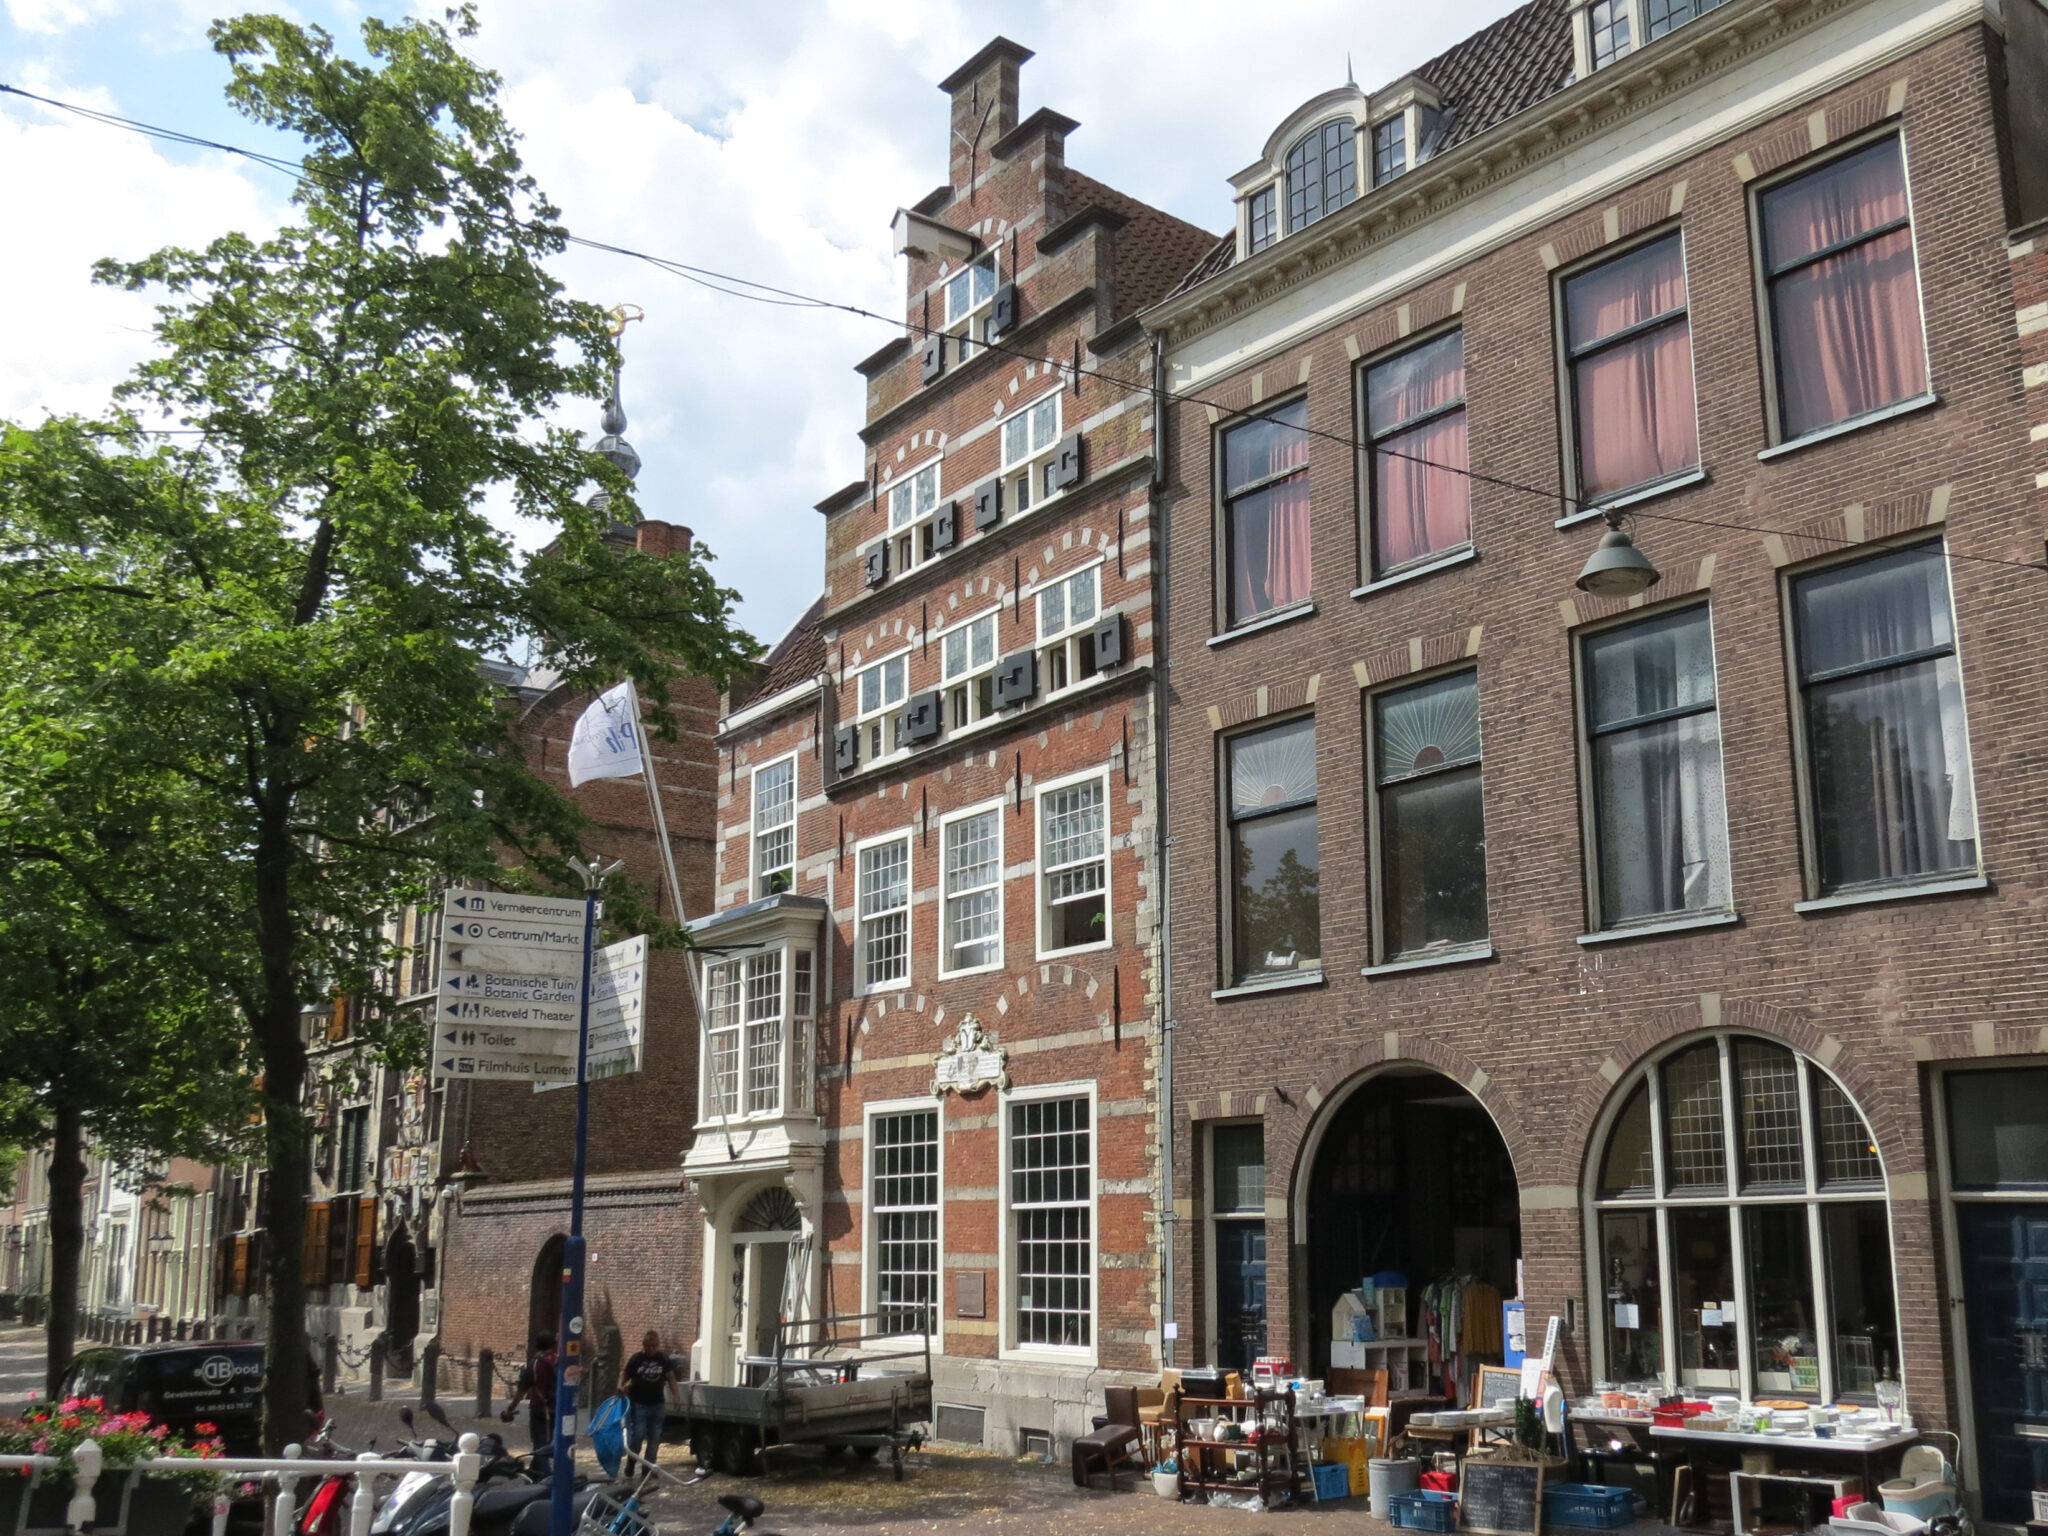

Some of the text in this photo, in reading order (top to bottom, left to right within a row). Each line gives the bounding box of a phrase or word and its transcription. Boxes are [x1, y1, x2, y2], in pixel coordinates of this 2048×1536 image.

[490, 899, 582, 918] Vermeercentrum
[488, 926, 580, 945] Centrum/Markt
[485, 974, 579, 991] Botanische Tuin/
[484, 986, 529, 1000] Botanic
[532, 989, 575, 1003] Garden
[483, 1006, 575, 1022] Rietveld Theater
[480, 1032, 517, 1047] Toilet
[478, 1058, 576, 1076] Filmhuis Lumen
